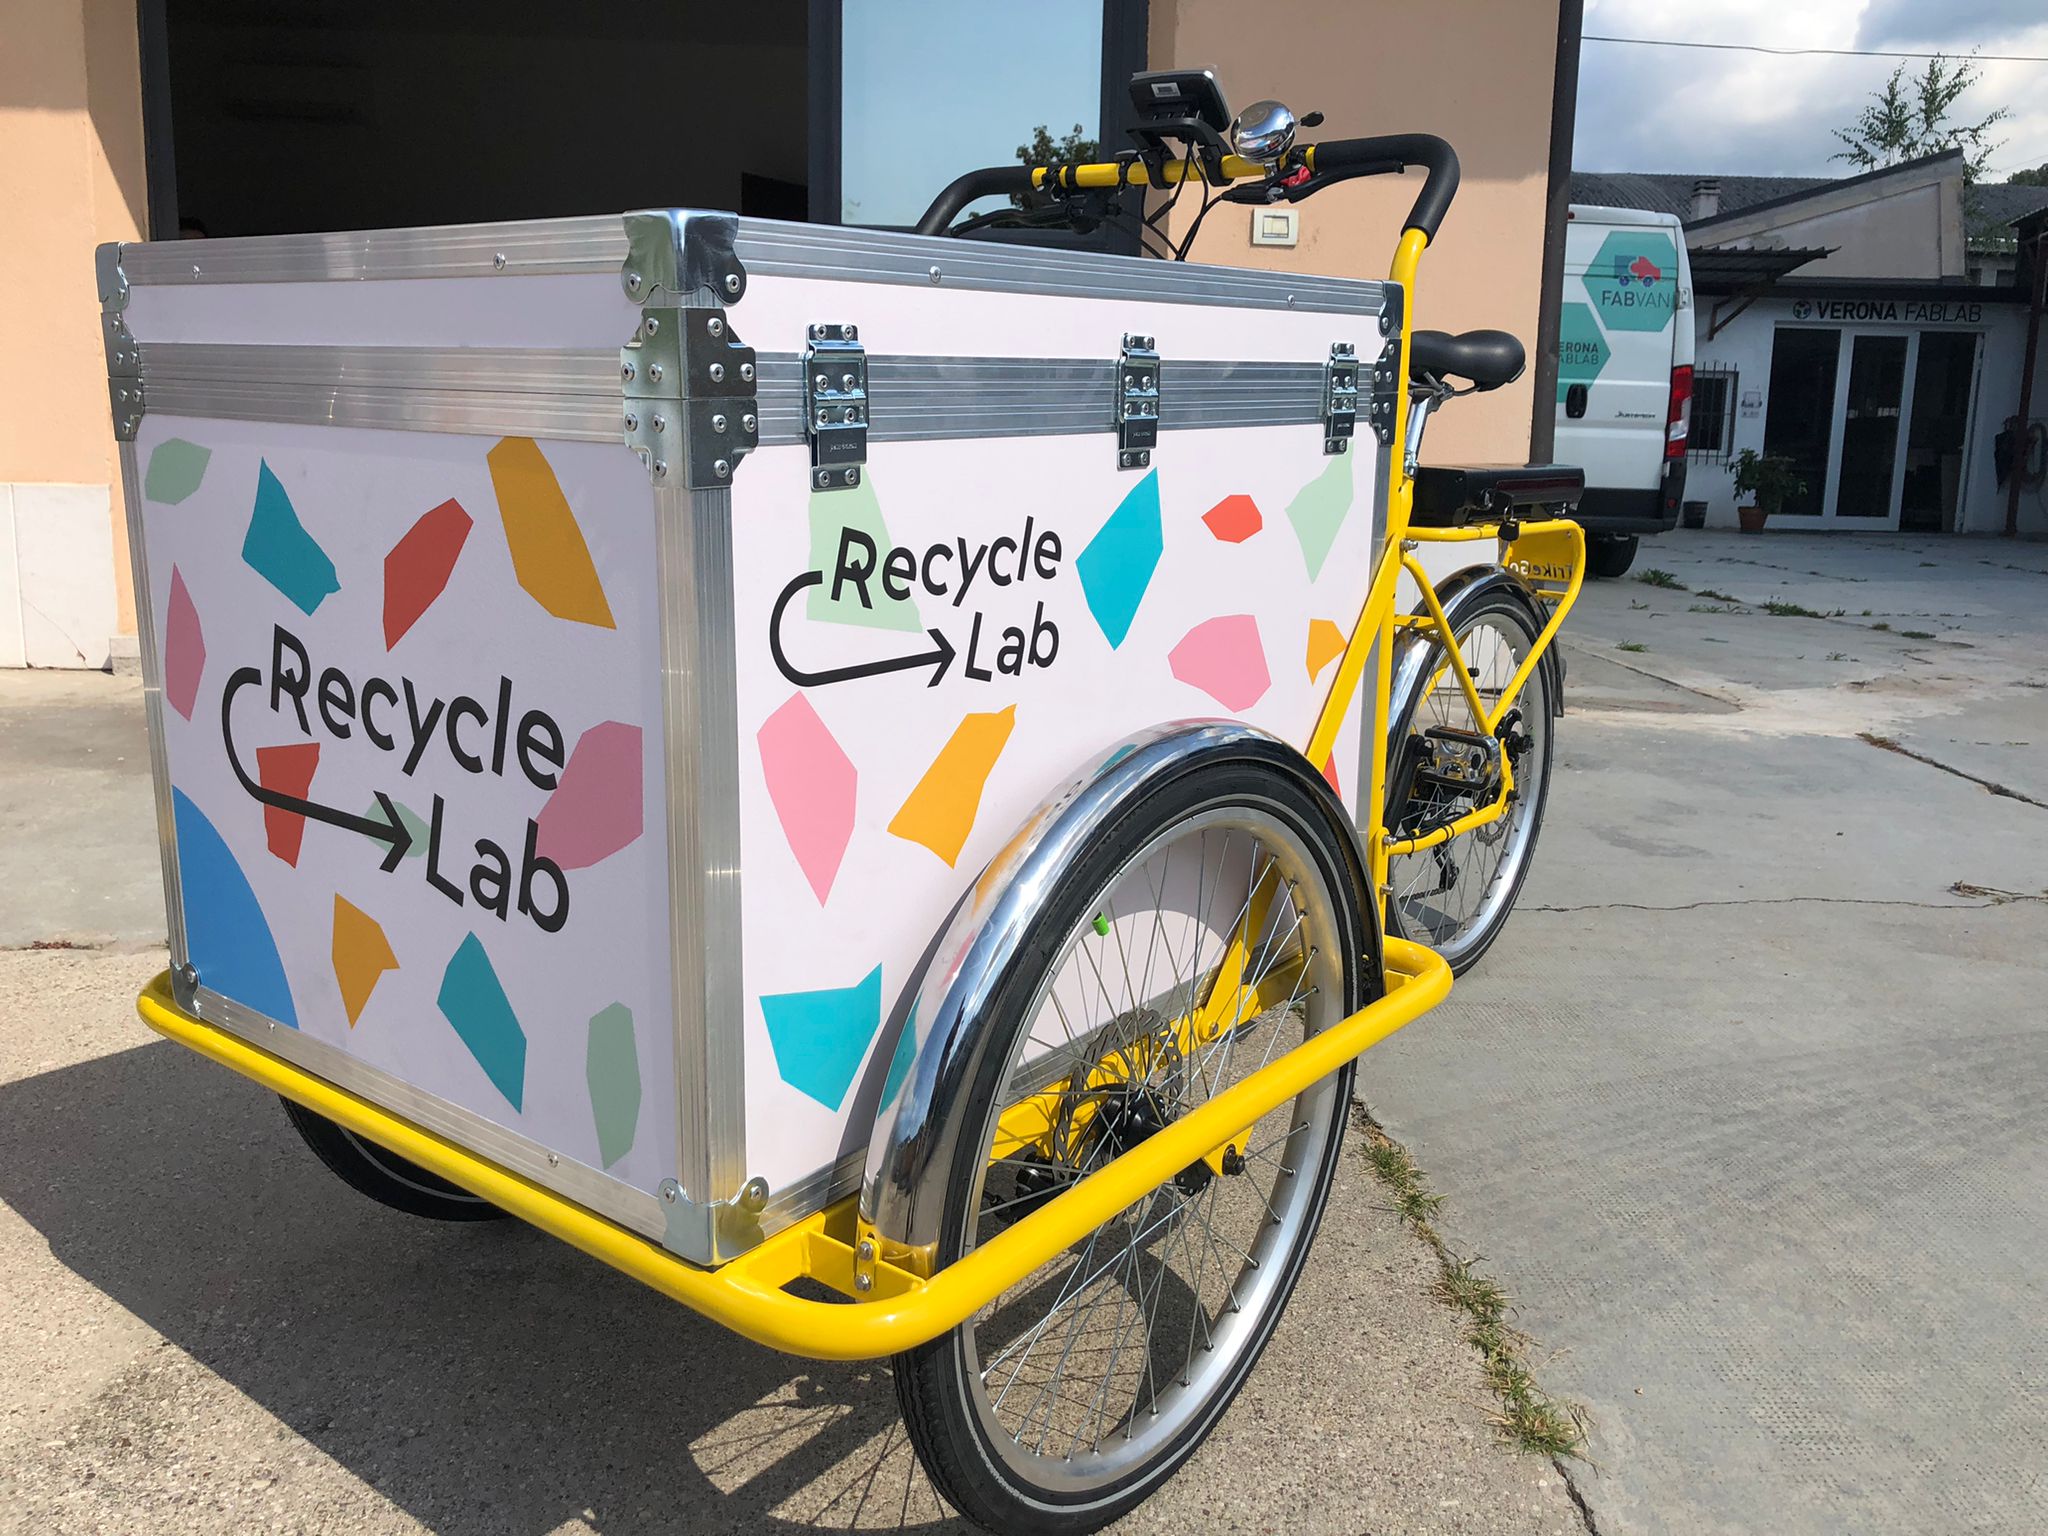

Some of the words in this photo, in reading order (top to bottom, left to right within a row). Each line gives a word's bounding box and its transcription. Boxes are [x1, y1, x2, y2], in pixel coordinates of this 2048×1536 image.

[1602, 290, 1669, 308] FABVAN
[1818, 301, 1897, 320] VERONA
[1905, 303, 1982, 322] FABLAB
[1559, 341, 1598, 353] ERONA
[1559, 353, 1599, 365] ABLAB
[831, 516, 1062, 609] Recycle
[965, 600, 1059, 682] Lab
[270, 623, 565, 791] Recycle
[426, 793, 569, 933] Lab
